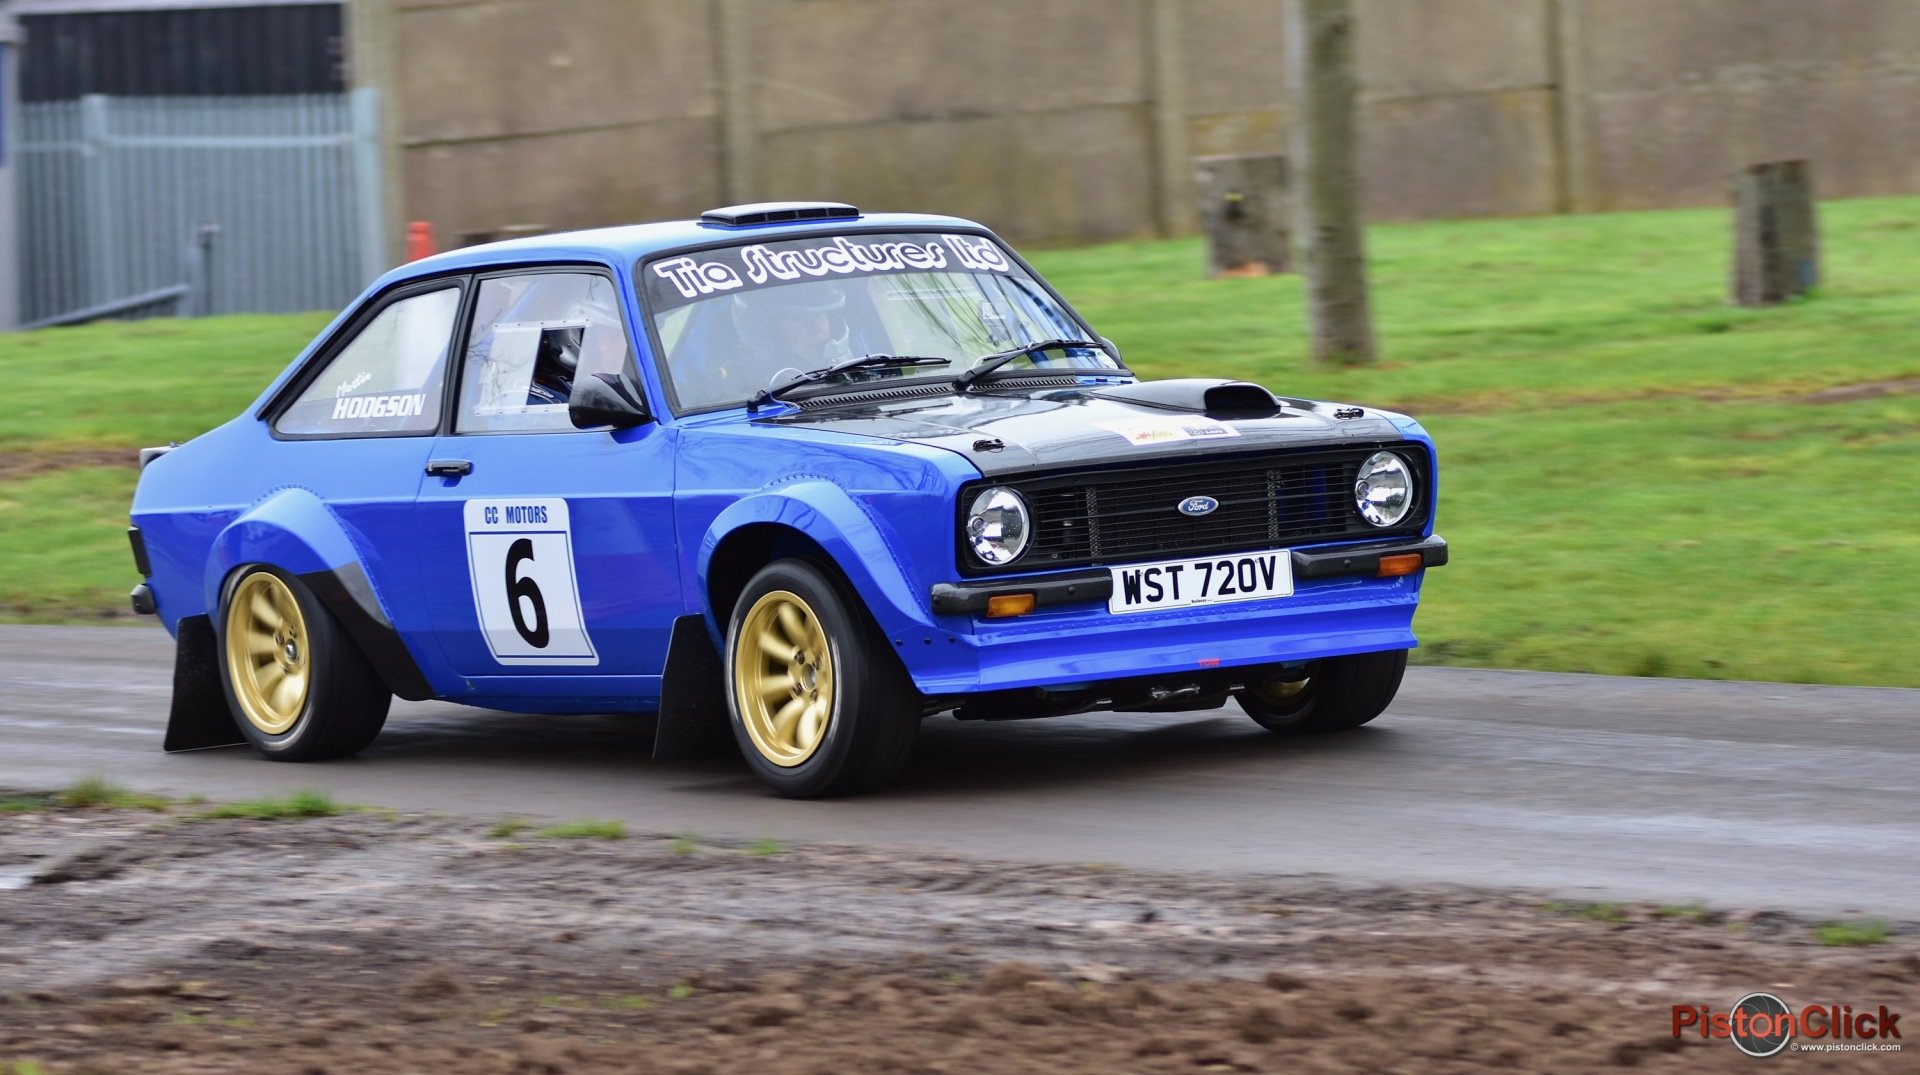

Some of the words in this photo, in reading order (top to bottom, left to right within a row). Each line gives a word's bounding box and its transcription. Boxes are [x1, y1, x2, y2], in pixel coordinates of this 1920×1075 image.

[653, 257, 743, 298] Tia
[741, 237, 947, 284] Structures
[332, 394, 426, 419] HODGSON
[485, 506, 498, 524] CC
[505, 506, 548, 524] MOTORS
[1188, 500, 1209, 512] Ford
[505, 538, 549, 649] 6
[1122, 565, 1184, 605] WST
[1194, 555, 1276, 597] 720V
